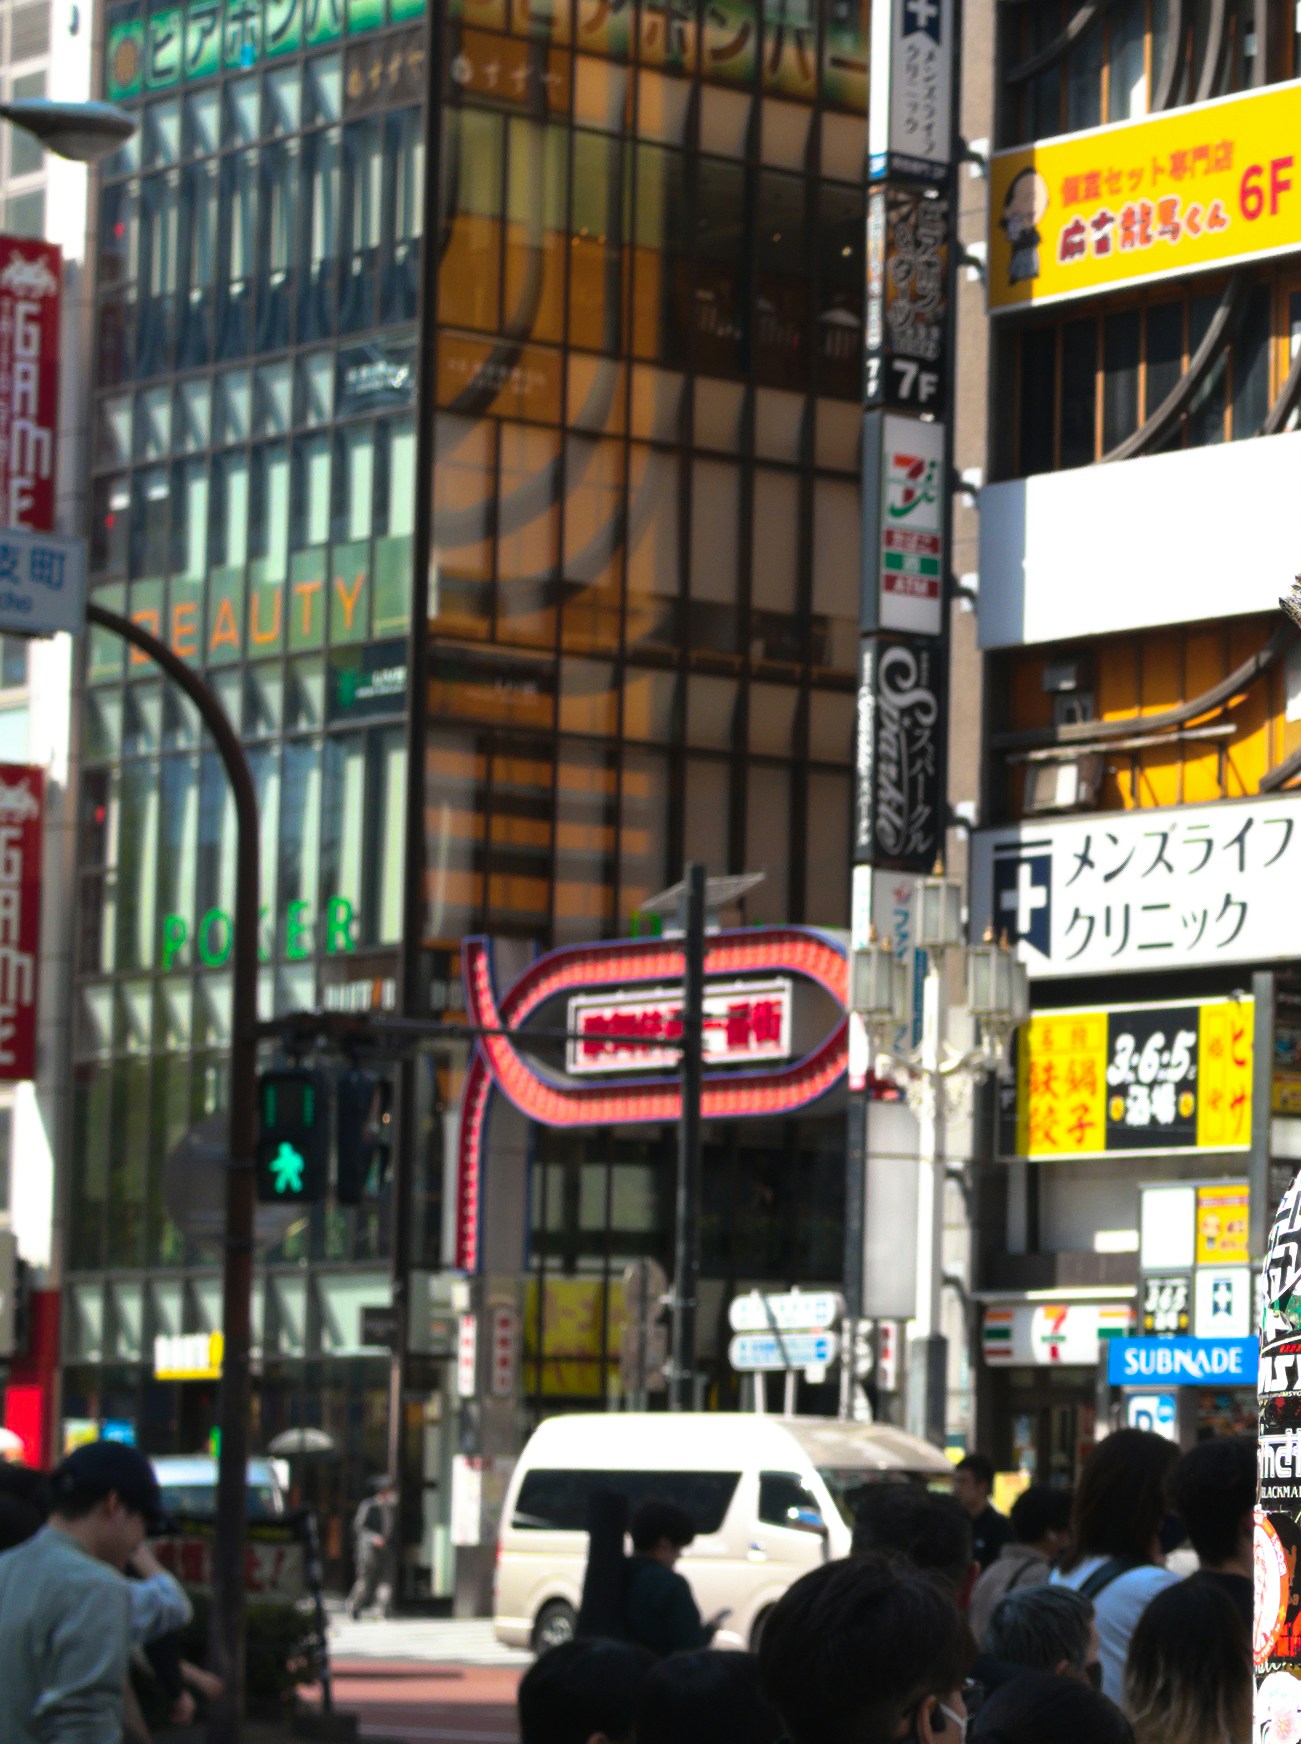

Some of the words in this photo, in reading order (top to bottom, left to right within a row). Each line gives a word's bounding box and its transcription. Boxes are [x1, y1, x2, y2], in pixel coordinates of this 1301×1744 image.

[1237, 157, 1294, 222] 6F
[891, 359, 940, 403] 7F
[129, 572, 366, 664] BEAUTY
[1065, 815, 1293, 887] メンズライフ
[1063, 892, 1249, 962] クリニック
[1123, 1345, 1245, 1377] SUBNADE
